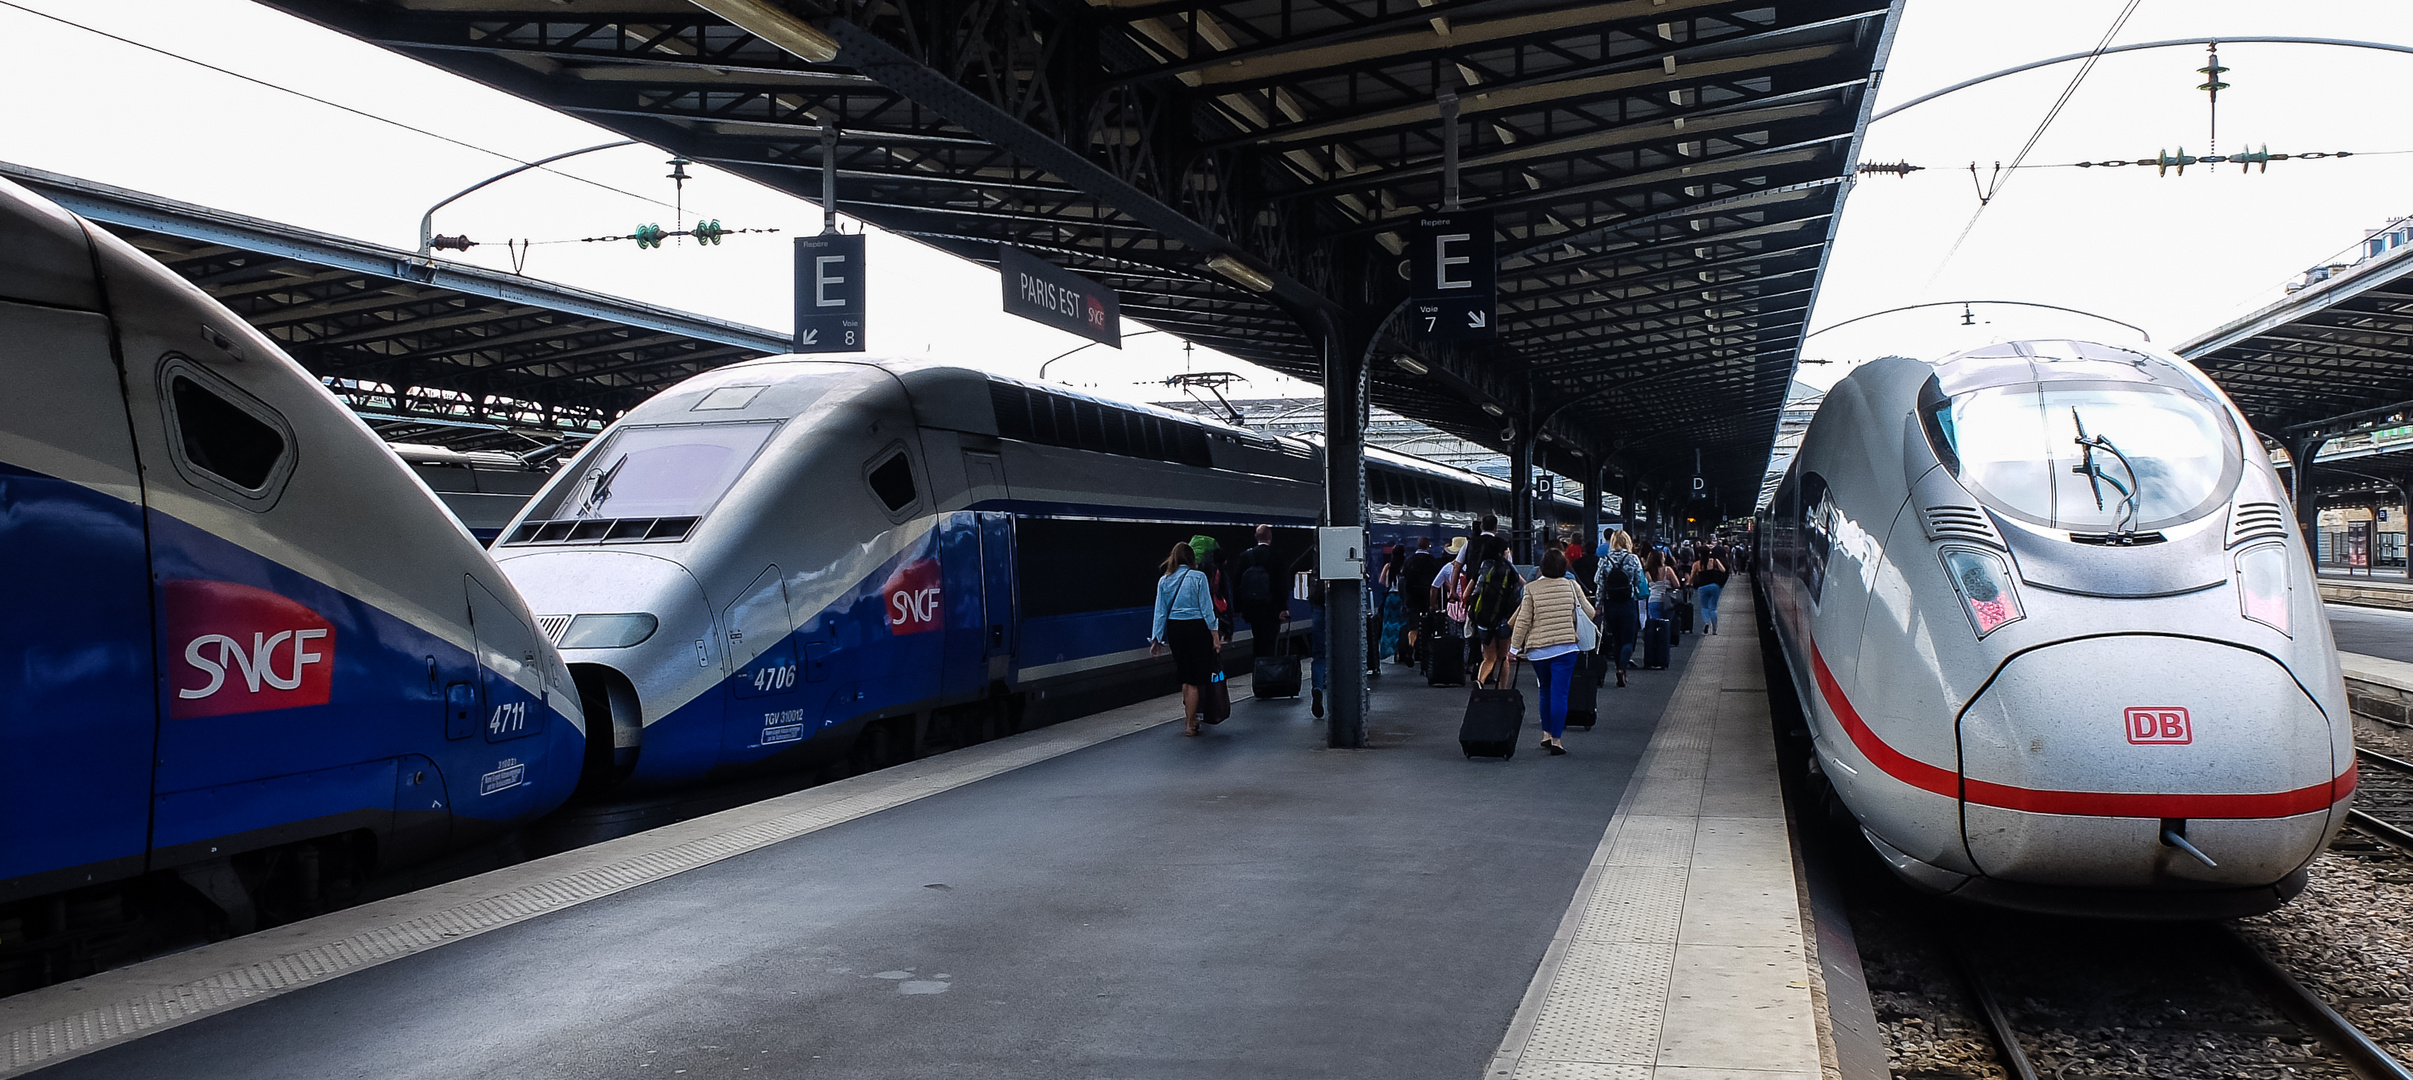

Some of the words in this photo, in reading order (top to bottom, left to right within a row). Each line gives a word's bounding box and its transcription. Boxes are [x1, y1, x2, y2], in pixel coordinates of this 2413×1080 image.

[1436, 233, 1472, 290] E
[816, 255, 846, 307] E
[1020, 272, 1057, 311] PARIS
[1059, 287, 1081, 319] EST
[1420, 305, 1439, 313] Voie
[1425, 316, 1436, 332] 7
[845, 330, 855, 346] 8
[1539, 479, 1551, 492] D
[1693, 477, 1705, 490] D
[892, 588, 941, 625] SNCF
[178, 628, 328, 700] SNCF
[754, 664, 797, 692] 4706
[489, 701, 525, 735] 4711
[764, 712, 780, 726] TGV
[2132, 712, 2184, 738] DB
